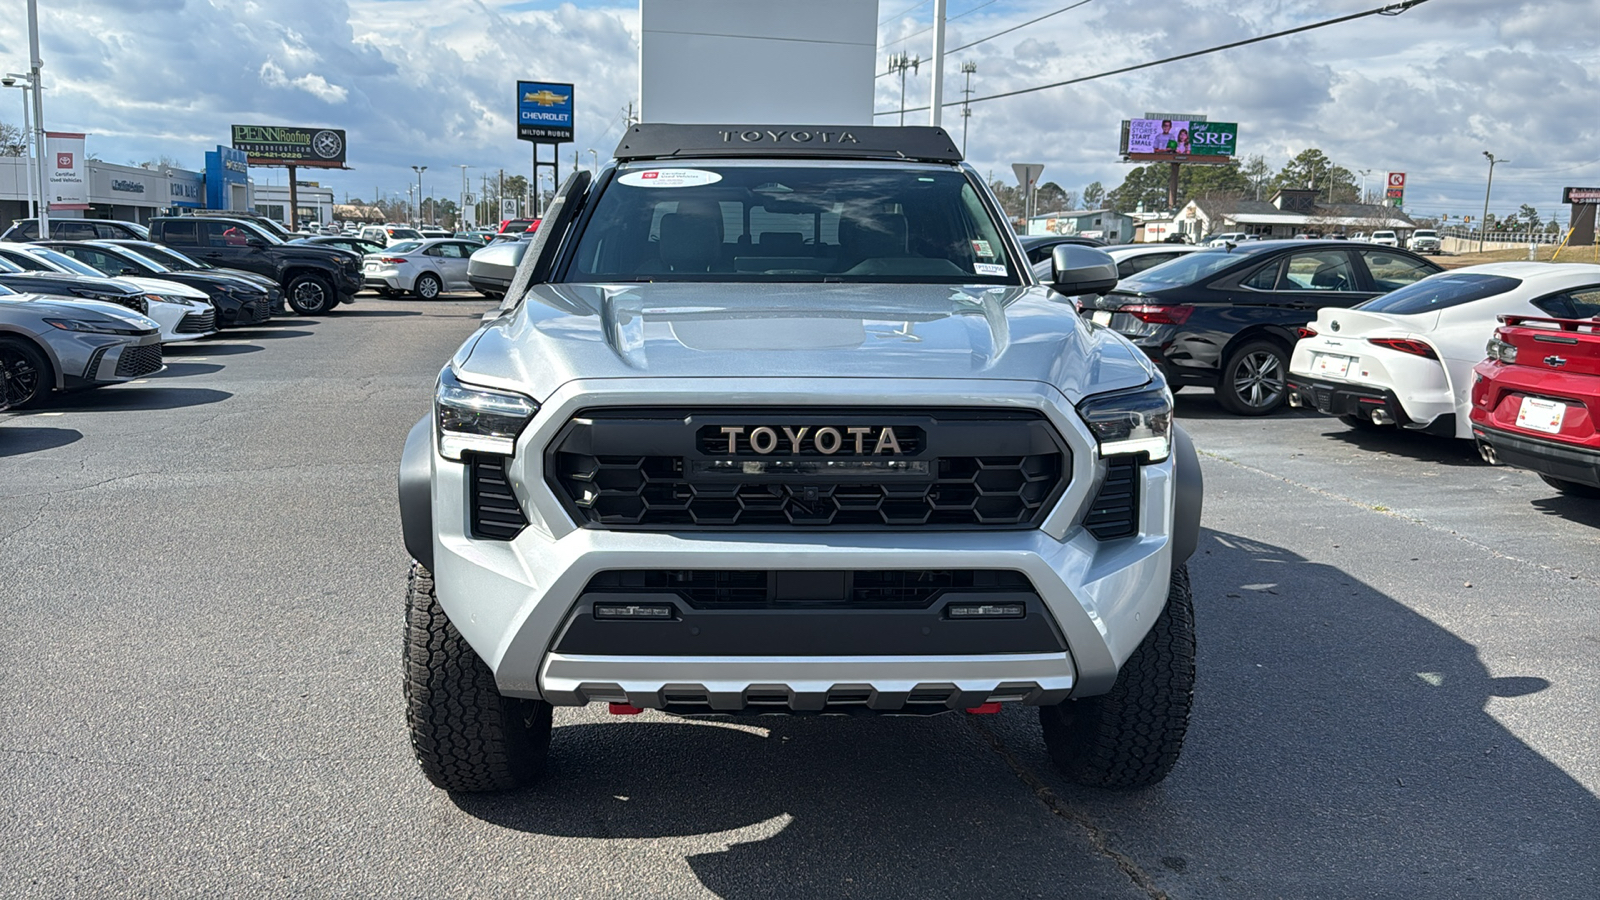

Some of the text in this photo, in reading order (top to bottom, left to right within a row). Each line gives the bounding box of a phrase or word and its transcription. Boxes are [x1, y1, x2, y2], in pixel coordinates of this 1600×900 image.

[522, 111, 569, 121] CHEVROLET
[234, 126, 283, 141] PENN
[280, 129, 311, 145] Roofing
[547, 130, 570, 138] RUBEN
[718, 130, 861, 144] TOYOTA
[1193, 131, 1233, 144] SRP
[721, 426, 902, 454] TOYOTA
